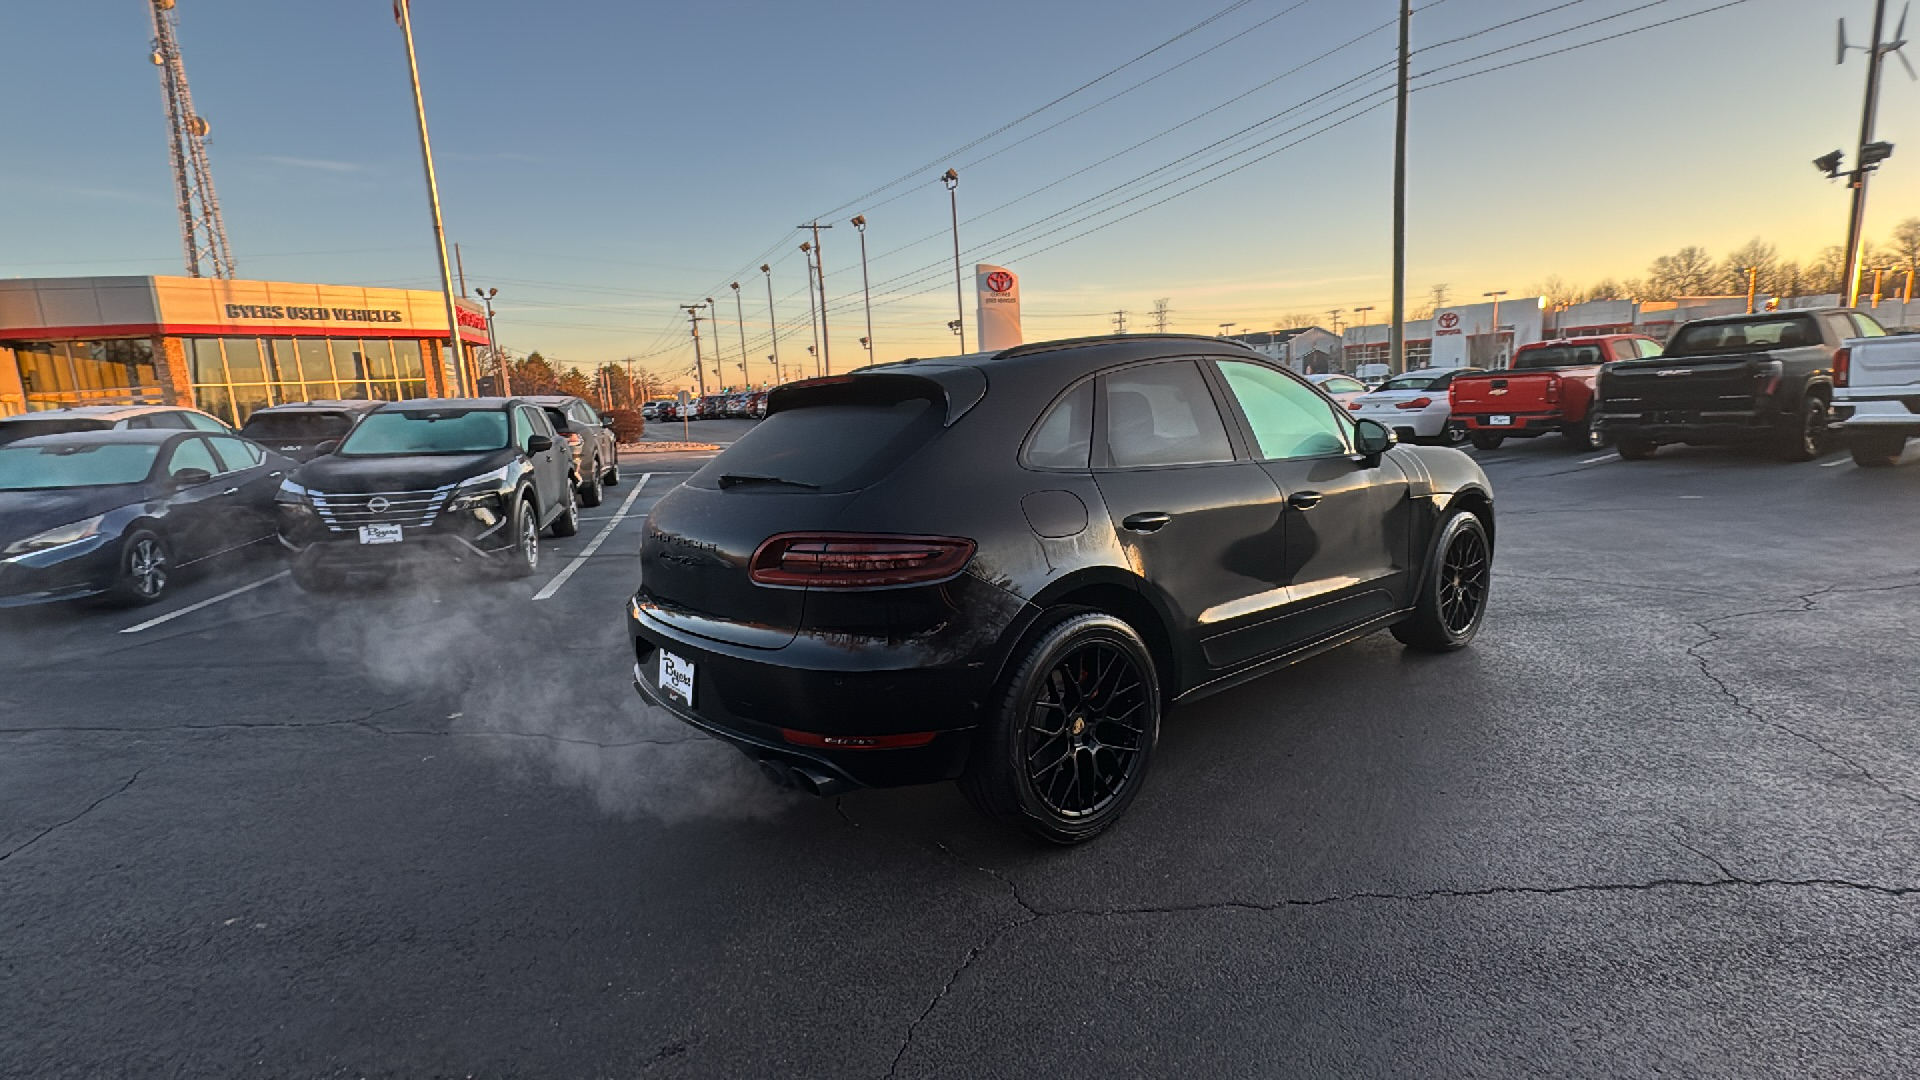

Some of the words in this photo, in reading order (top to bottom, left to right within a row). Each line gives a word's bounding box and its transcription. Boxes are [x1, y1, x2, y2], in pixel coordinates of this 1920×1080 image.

[225, 303, 285, 319] BYERS
[286, 306, 331, 320] USED
[332, 308, 403, 322] VEHICLES
